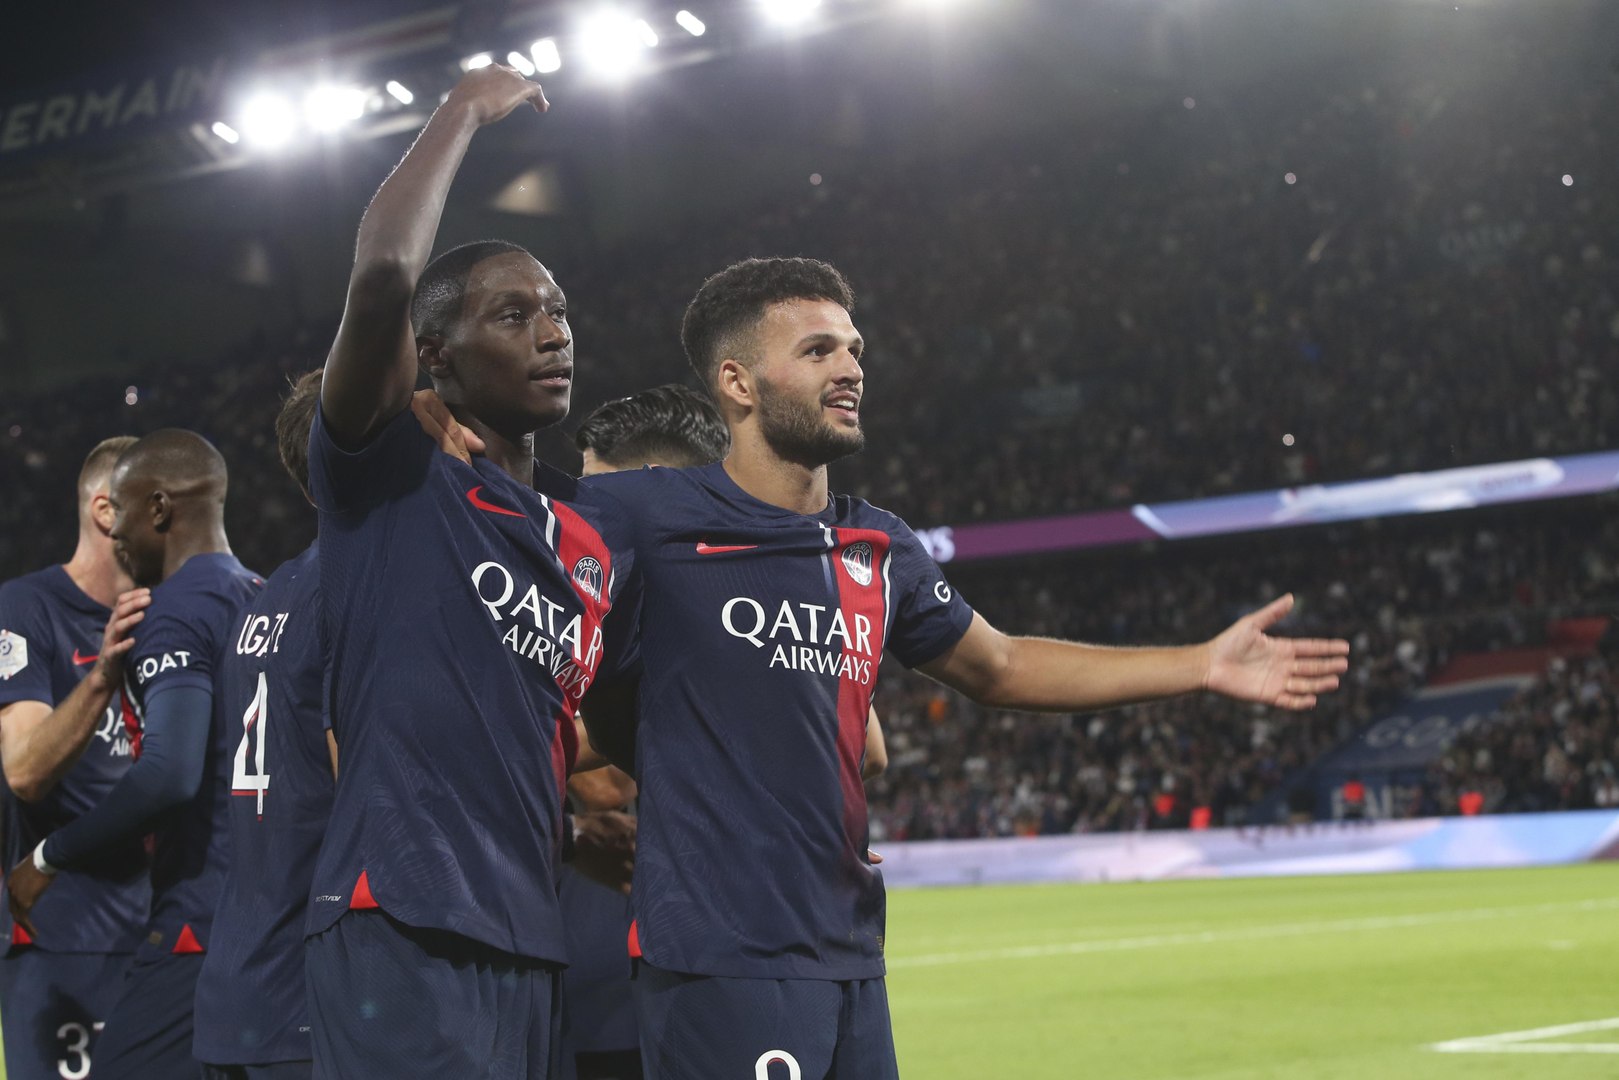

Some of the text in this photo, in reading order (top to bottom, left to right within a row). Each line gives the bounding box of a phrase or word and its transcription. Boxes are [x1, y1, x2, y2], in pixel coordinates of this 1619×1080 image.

[0, 63, 220, 151] ERMAIN
[578, 559, 600, 574] PARIS
[471, 561, 603, 673] QATAR
[721, 596, 873, 657] QATAR
[136, 650, 191, 685] GOAT
[502, 624, 590, 699] AIRWAYS
[769, 643, 872, 685] AIRWAYS
[231, 671, 271, 815] 4
[57, 1022, 106, 1080] 3
